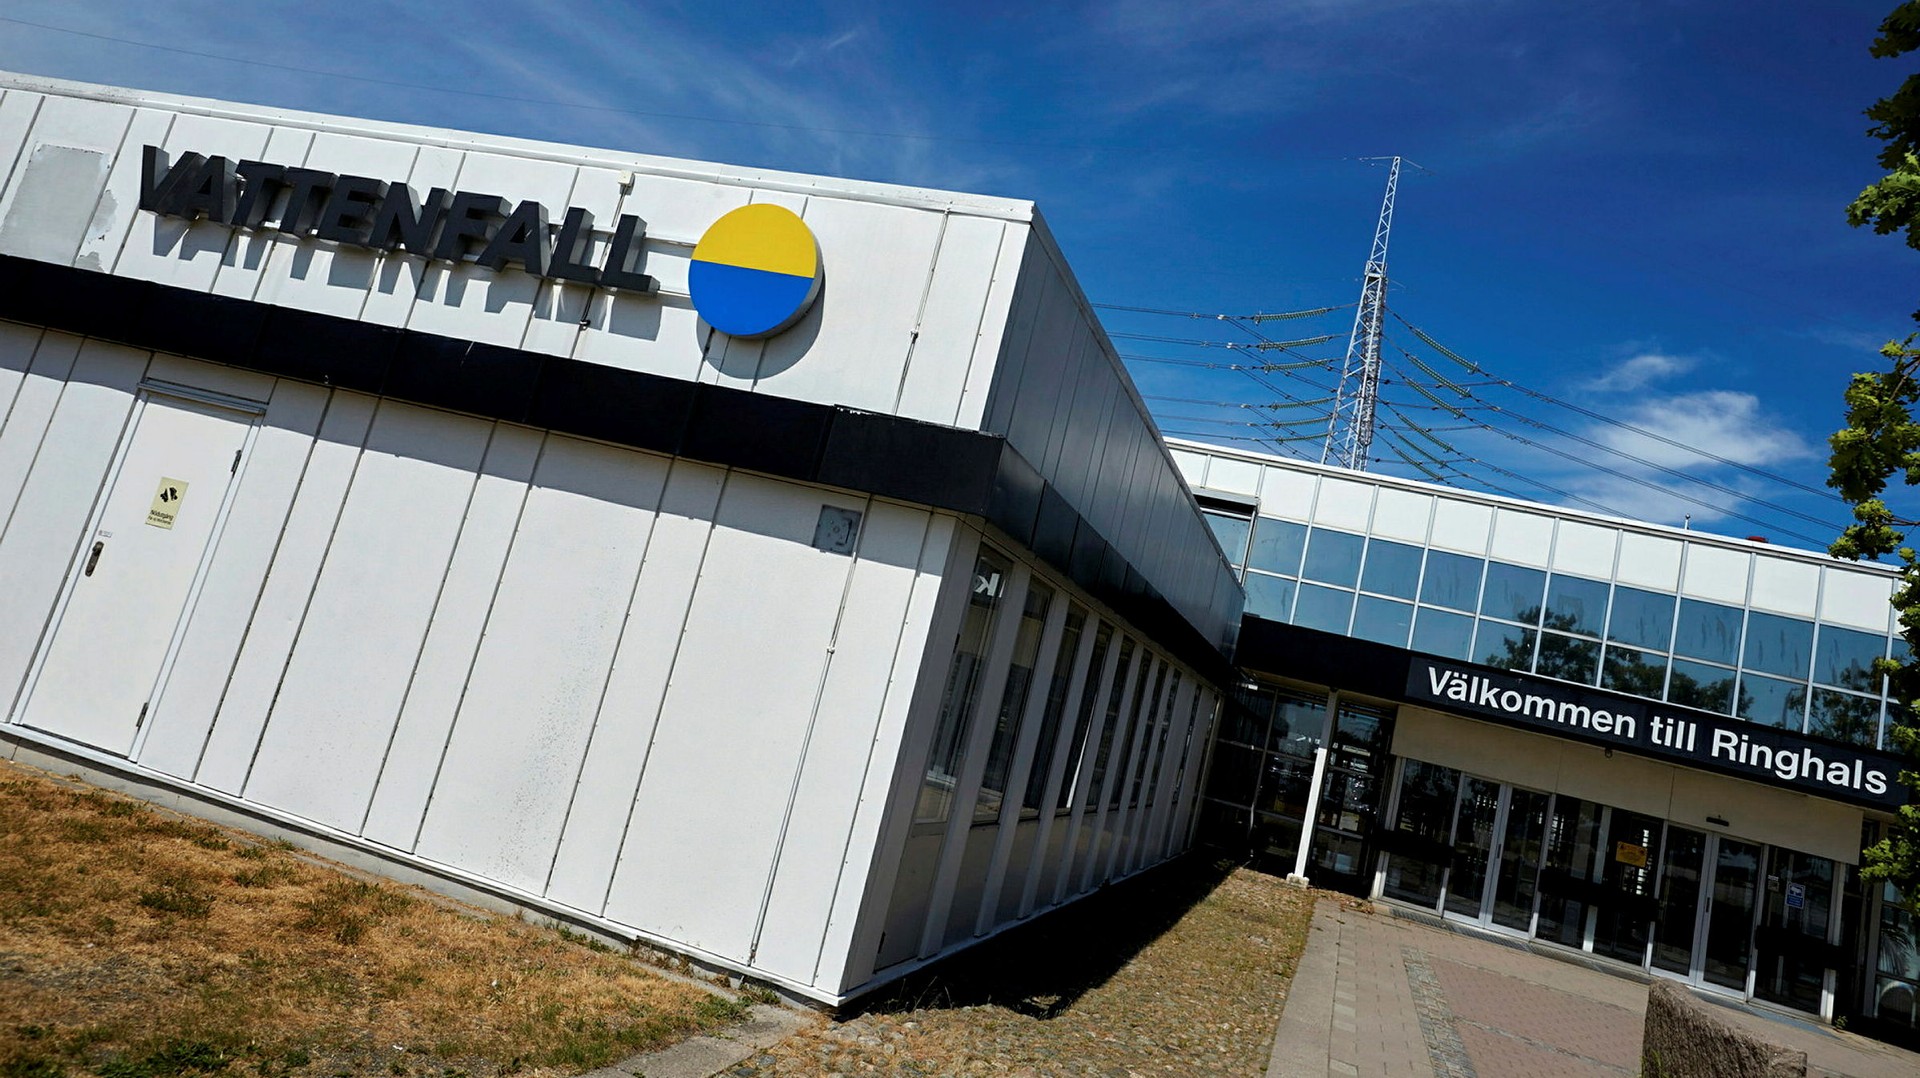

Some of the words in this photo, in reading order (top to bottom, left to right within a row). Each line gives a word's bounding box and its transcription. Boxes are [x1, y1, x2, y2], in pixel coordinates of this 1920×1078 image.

[139, 144, 660, 295] VATTENFALL
[1428, 666, 1636, 739] Välkommen
[1650, 716, 1697, 752] till
[1711, 728, 1887, 794] Ringhals
